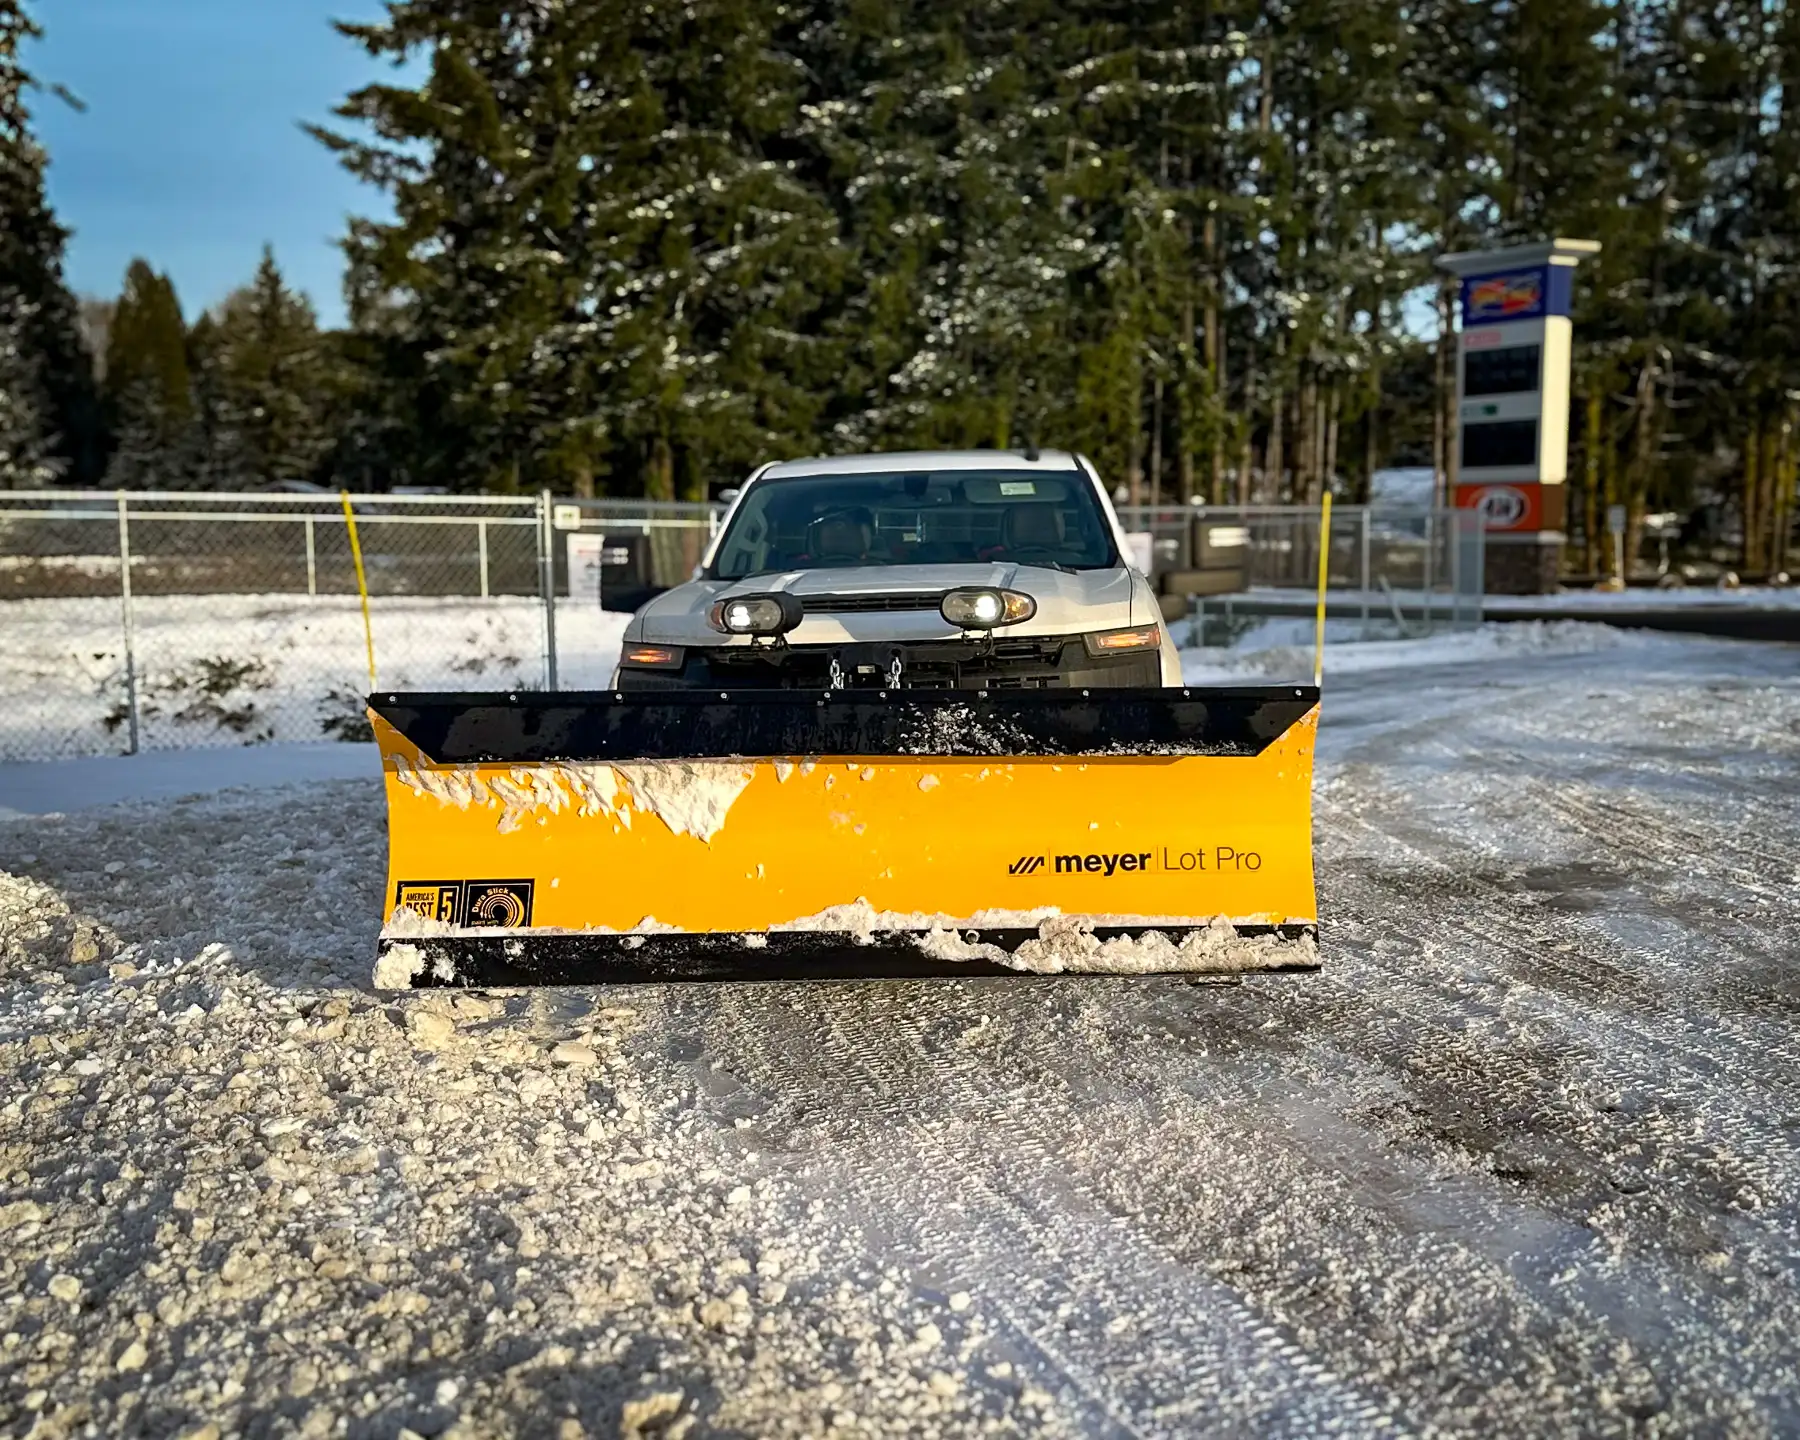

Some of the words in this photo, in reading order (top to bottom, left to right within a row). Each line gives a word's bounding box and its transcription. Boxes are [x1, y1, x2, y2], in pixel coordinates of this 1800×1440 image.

[1055, 853, 1152, 876] meyer
[1164, 848, 1206, 871] Lot
[1216, 847, 1262, 870] Pro
[405, 892, 434, 902] AMERICA'S
[441, 891, 453, 921] 5
[472, 894, 487, 912] Dura
[486, 887, 509, 896] Slick
